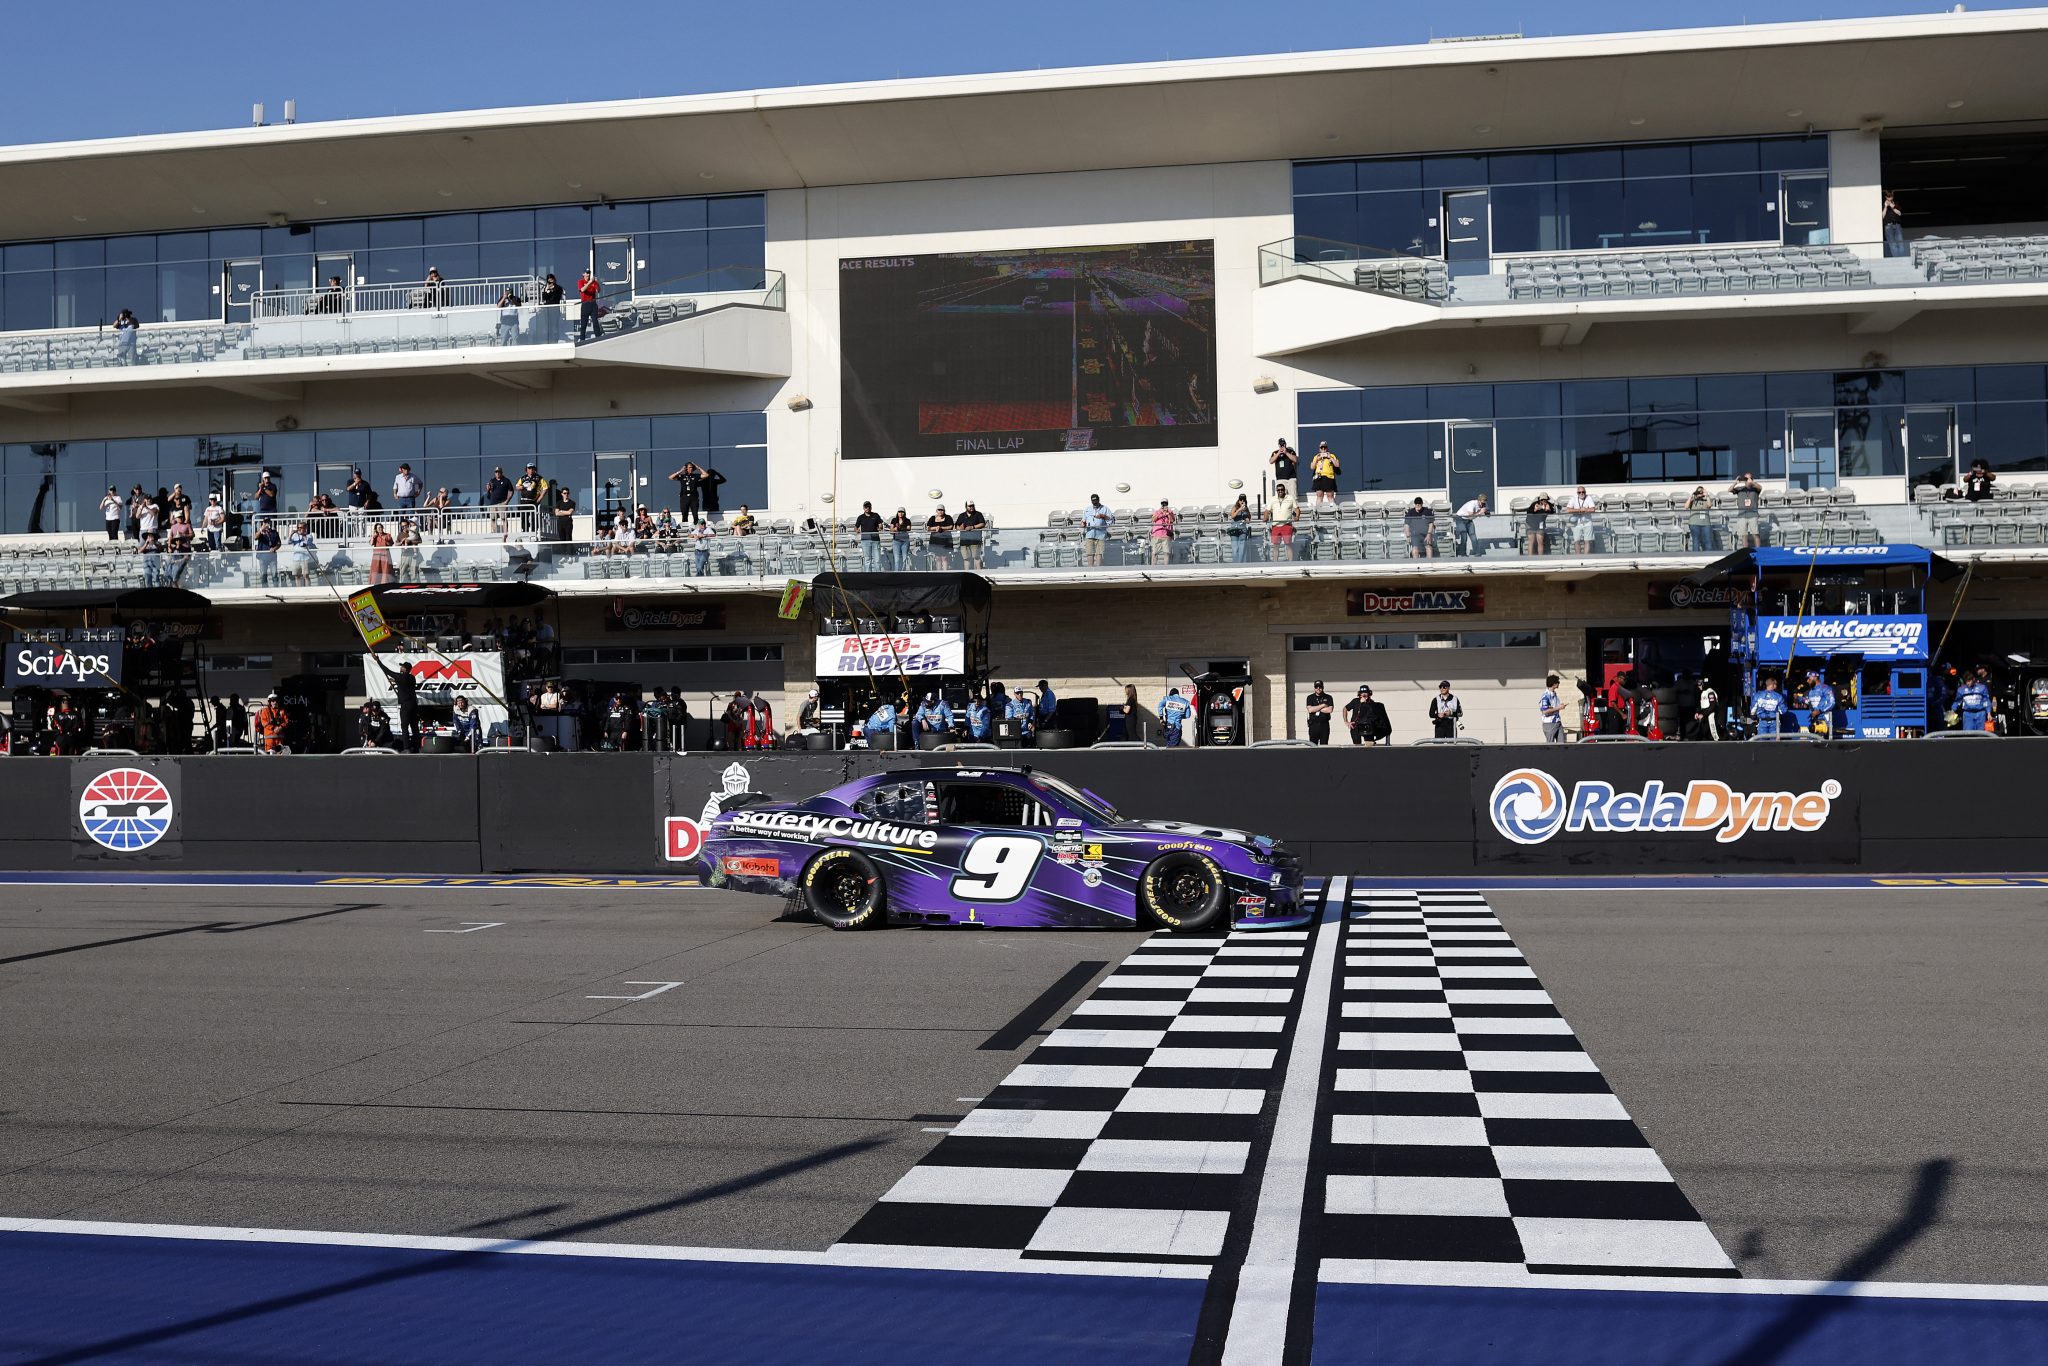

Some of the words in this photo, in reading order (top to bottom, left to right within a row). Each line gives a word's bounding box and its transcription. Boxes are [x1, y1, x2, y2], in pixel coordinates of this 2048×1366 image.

[841, 260, 862, 270] ACE
[865, 258, 915, 269] RESULTS
[956, 438, 993, 451] FINAL
[998, 437, 1024, 449] LAP
[842, 636, 921, 653] ROTO-
[17, 649, 109, 682] SciAps
[837, 654, 941, 672] ROOTER
[1862, 727, 1890, 736] WILDE
[736, 826, 757, 834] better
[757, 829, 772, 837] way
[772, 829, 780, 837] of
[781, 831, 809, 842] working
[1157, 841, 1213, 852] GOODYEAR
[742, 861, 775, 872] Kubota
[805, 851, 850, 887] GOODYEAR
[949, 832, 1048, 905] 9
[1201, 857, 1223, 885] EAGLE
[1146, 875, 1181, 926] GOODYEAR
[848, 905, 874, 926] EAGLE
